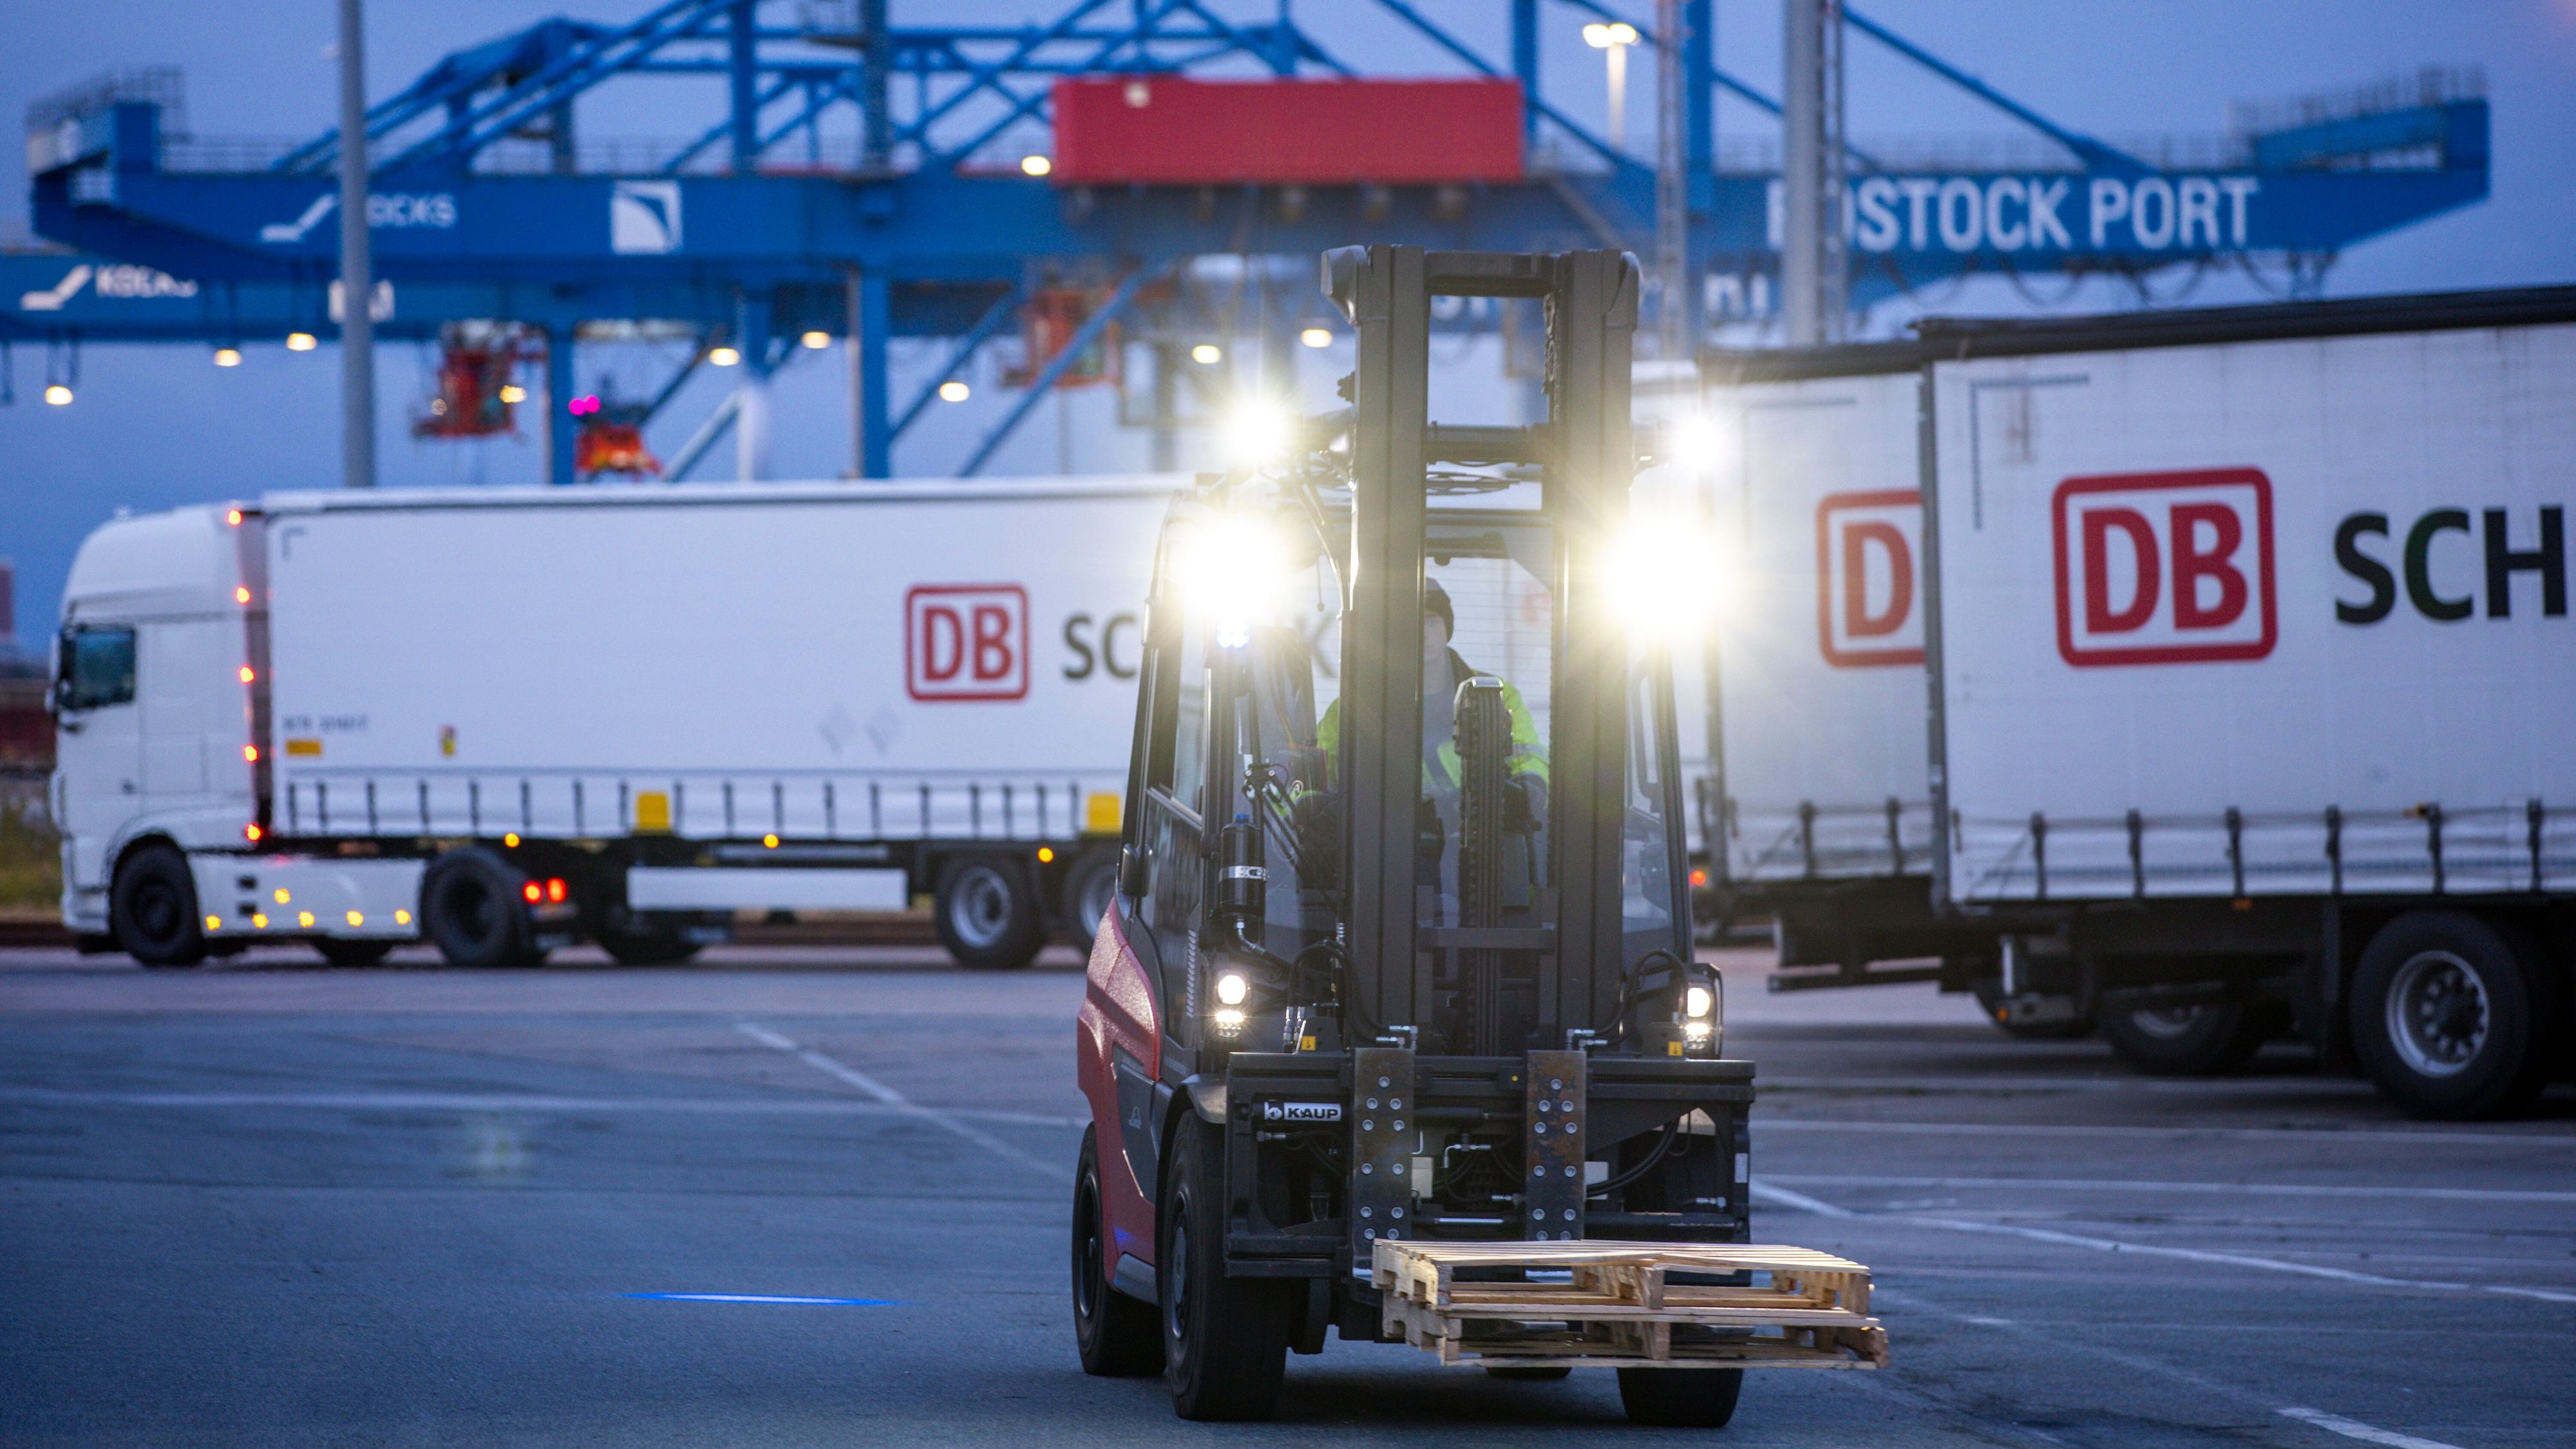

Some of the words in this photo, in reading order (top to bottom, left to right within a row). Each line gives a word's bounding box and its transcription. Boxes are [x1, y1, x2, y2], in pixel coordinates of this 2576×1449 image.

[2090, 177, 2259, 250] PORT
[1841, 522, 1913, 638] D
[2081, 502, 2248, 634] DB
[2334, 504, 2567, 625] SCH
[922, 605, 1013, 683] DB
[1288, 1107, 1339, 1119] KAUP
